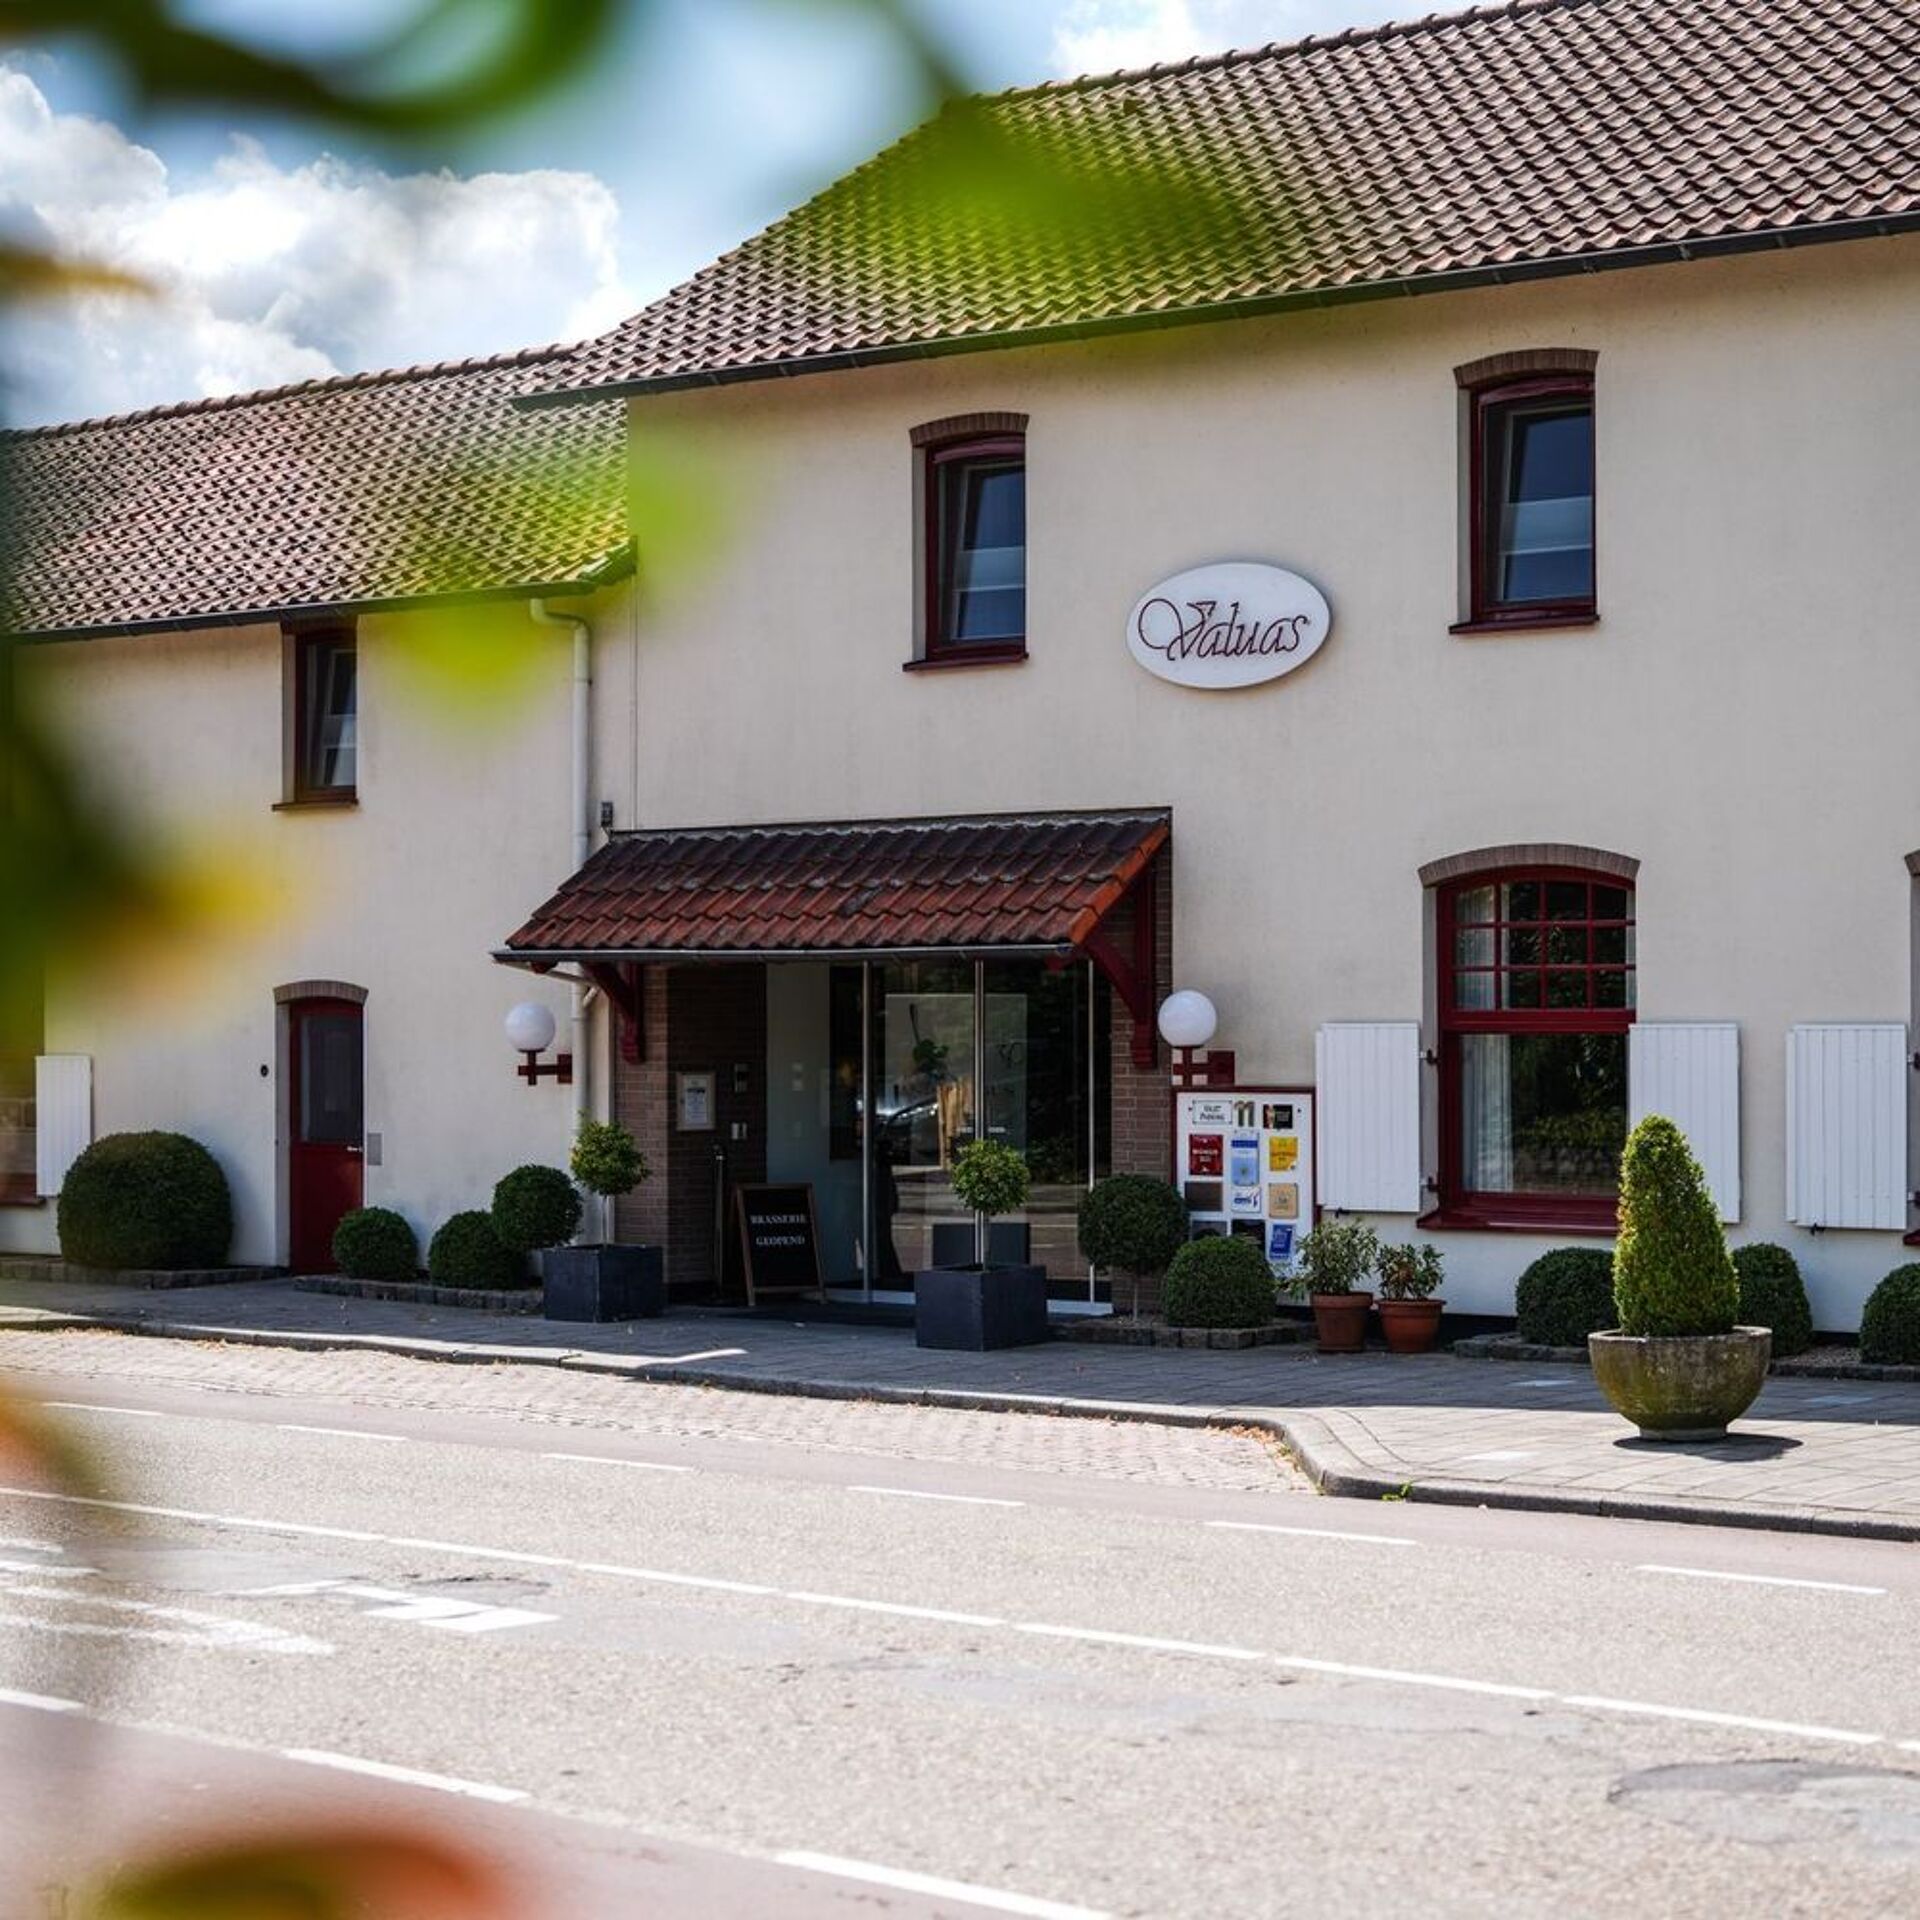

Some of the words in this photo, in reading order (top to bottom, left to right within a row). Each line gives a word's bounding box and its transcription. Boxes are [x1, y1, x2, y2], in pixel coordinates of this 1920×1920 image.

[1138, 598, 1309, 661] Valuas
[750, 1214, 806, 1224] BRASSERIE
[756, 1236, 805, 1245] GEOPEND
